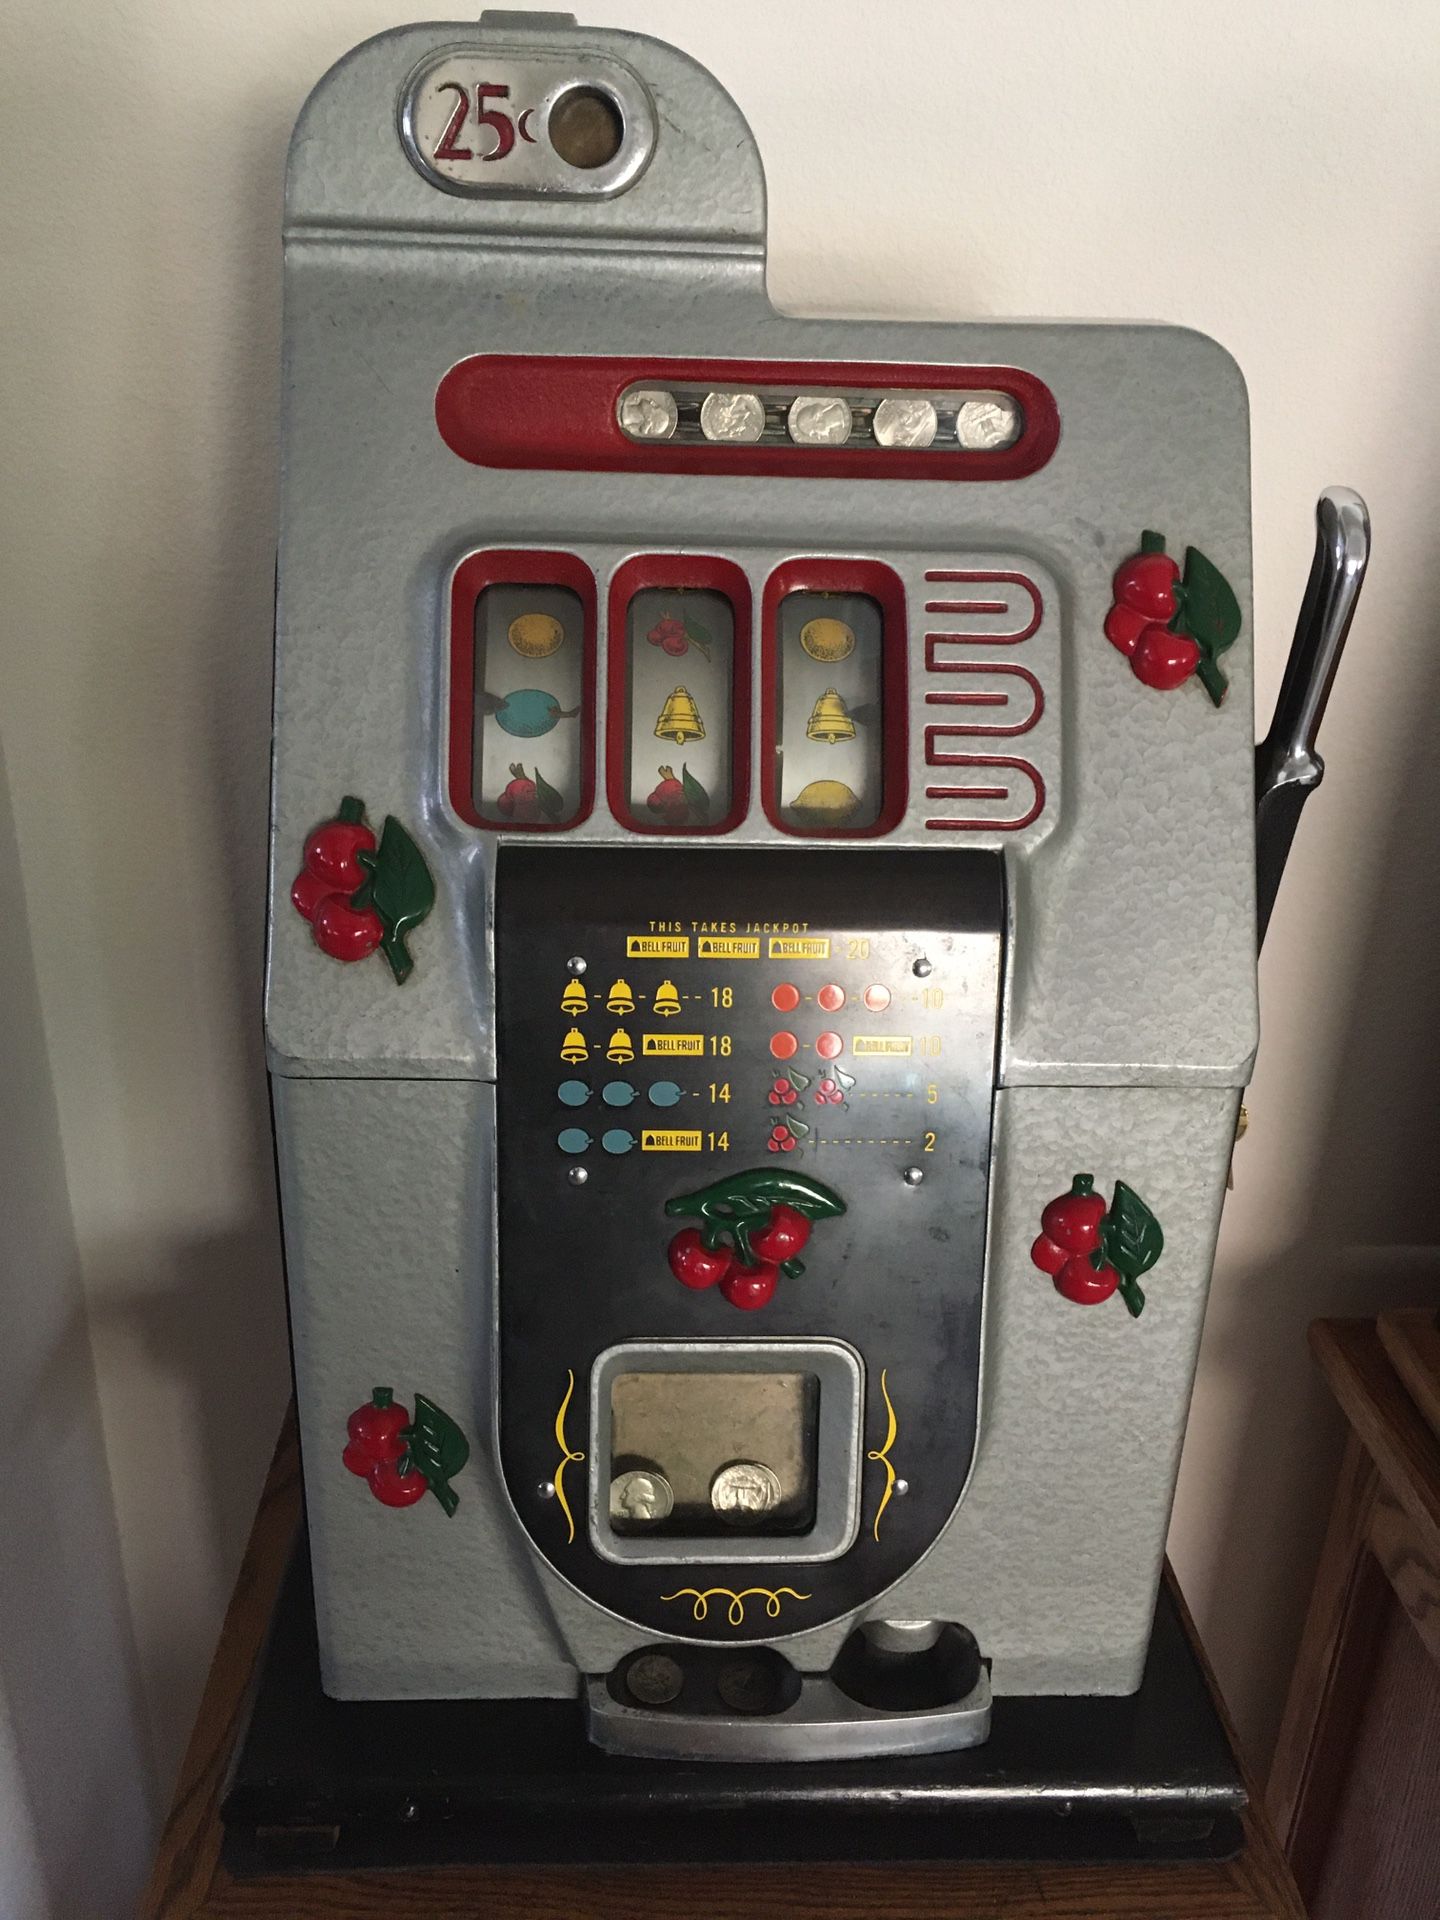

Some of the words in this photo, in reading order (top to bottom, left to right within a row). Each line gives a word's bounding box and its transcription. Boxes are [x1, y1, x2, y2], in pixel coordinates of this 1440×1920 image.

[649, 921, 682, 933] THIS
[691, 922, 737, 934] TAKES
[746, 922, 809, 934] JACKPOT
[641, 941, 661, 953] BELL
[661, 941, 687, 953] FRUIT
[712, 941, 731, 954] BELL
[732, 942, 758, 954] FRUIT
[846, 938, 871, 960] 20
[711, 986, 734, 1009] 18
[921, 986, 944, 1009] 10
[657, 1039, 676, 1051] BELL
[677, 1039, 701, 1051] FRUIT
[710, 1035, 733, 1057] 18
[920, 1035, 942, 1057] 10
[708, 1082, 732, 1104] 14
[927, 1083, 938, 1105] 5
[655, 1135, 674, 1147] BELL
[675, 1135, 699, 1147] FRUIT
[707, 1131, 730, 1152] 14
[924, 1131, 937, 1153] 2
